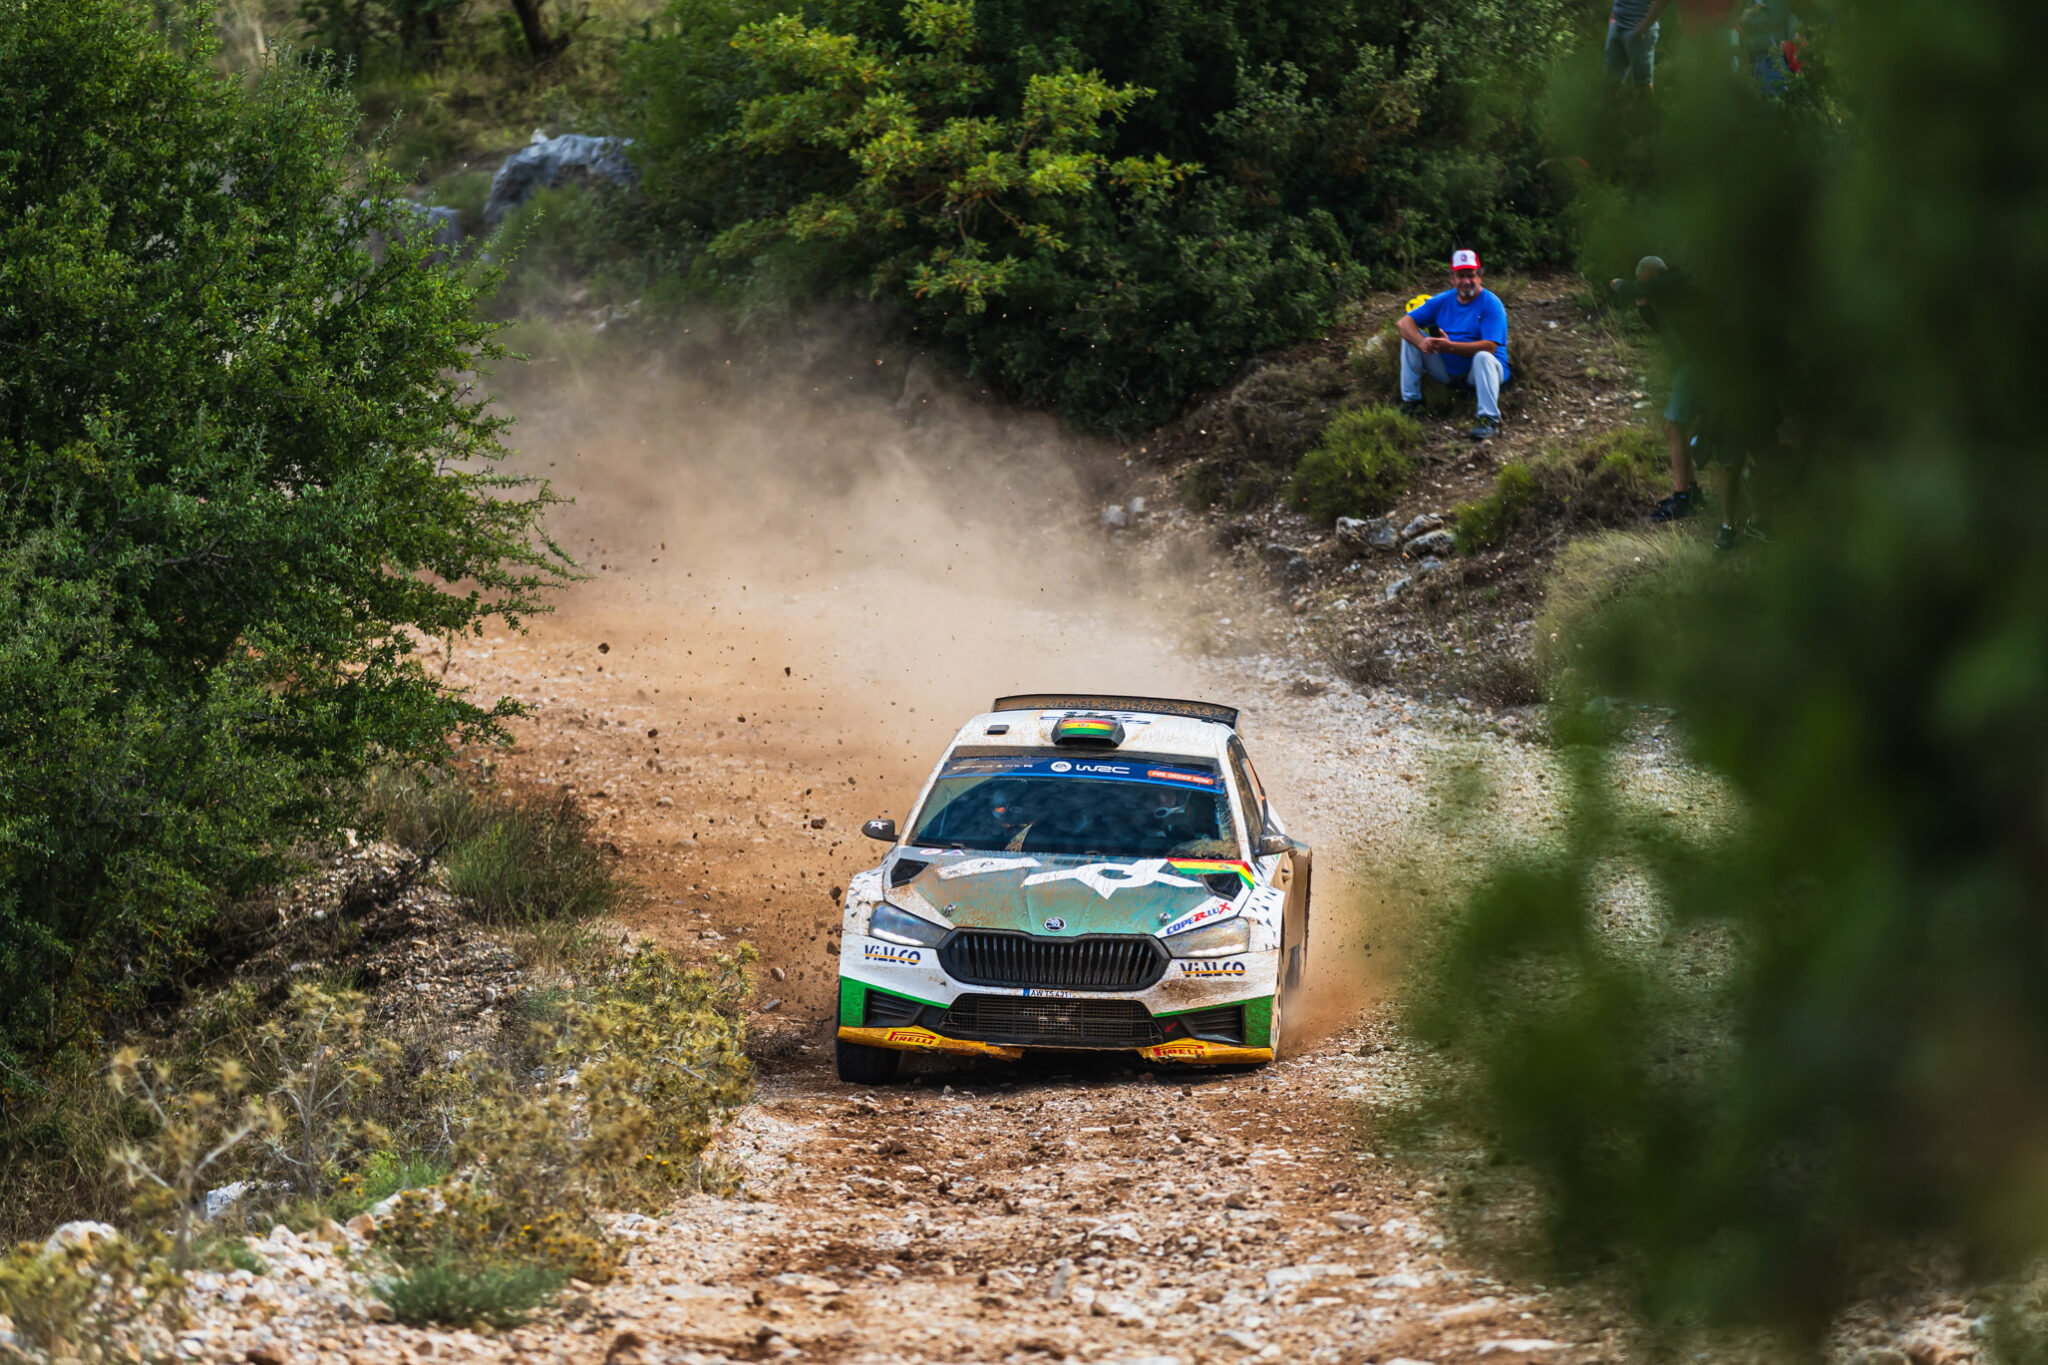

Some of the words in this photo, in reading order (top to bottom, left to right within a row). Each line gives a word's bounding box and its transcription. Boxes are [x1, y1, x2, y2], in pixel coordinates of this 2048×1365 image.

[1076, 763, 1130, 775] WRC
[1166, 902, 1231, 935] COPERLUX
[888, 1031, 936, 1045] PIRELLI
[1153, 1044, 1206, 1057] PIRELLI
